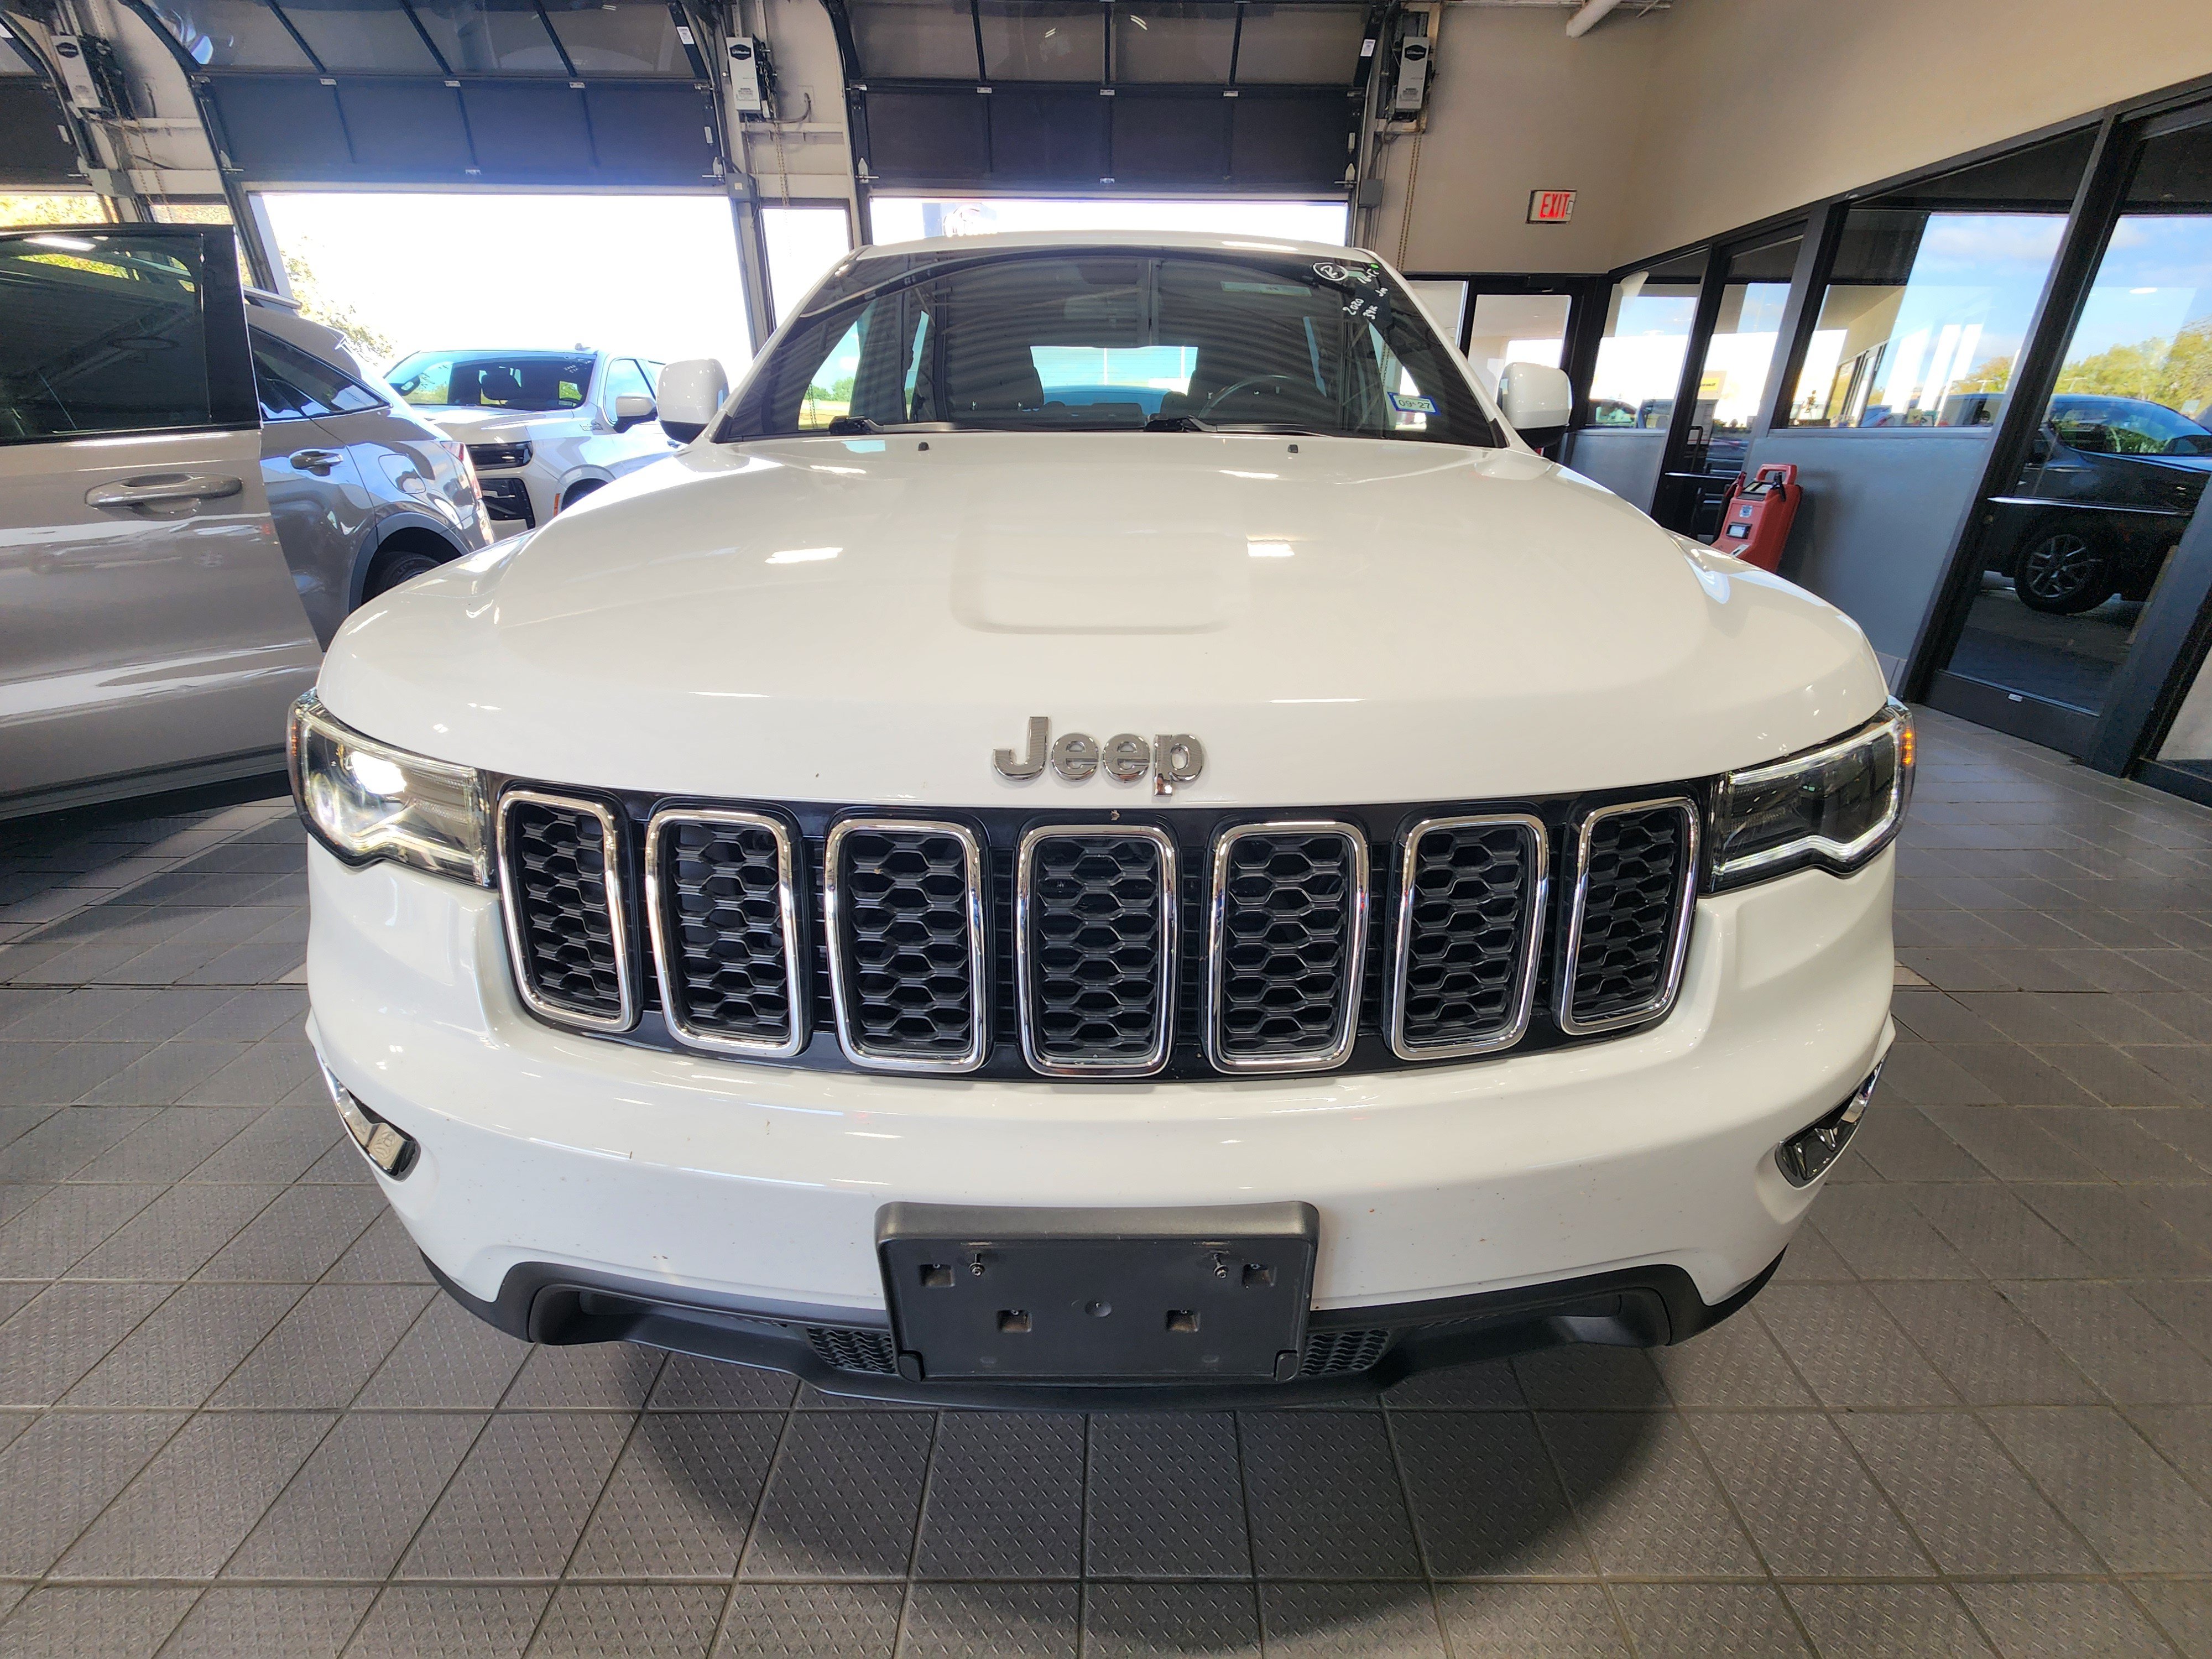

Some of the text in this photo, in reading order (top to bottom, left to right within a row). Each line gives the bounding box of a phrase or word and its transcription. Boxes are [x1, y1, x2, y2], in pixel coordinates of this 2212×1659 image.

[1540, 193, 1571, 218] EXIT
[1342, 298, 1364, 315] 2020
[993, 717, 1205, 797] Jeep
